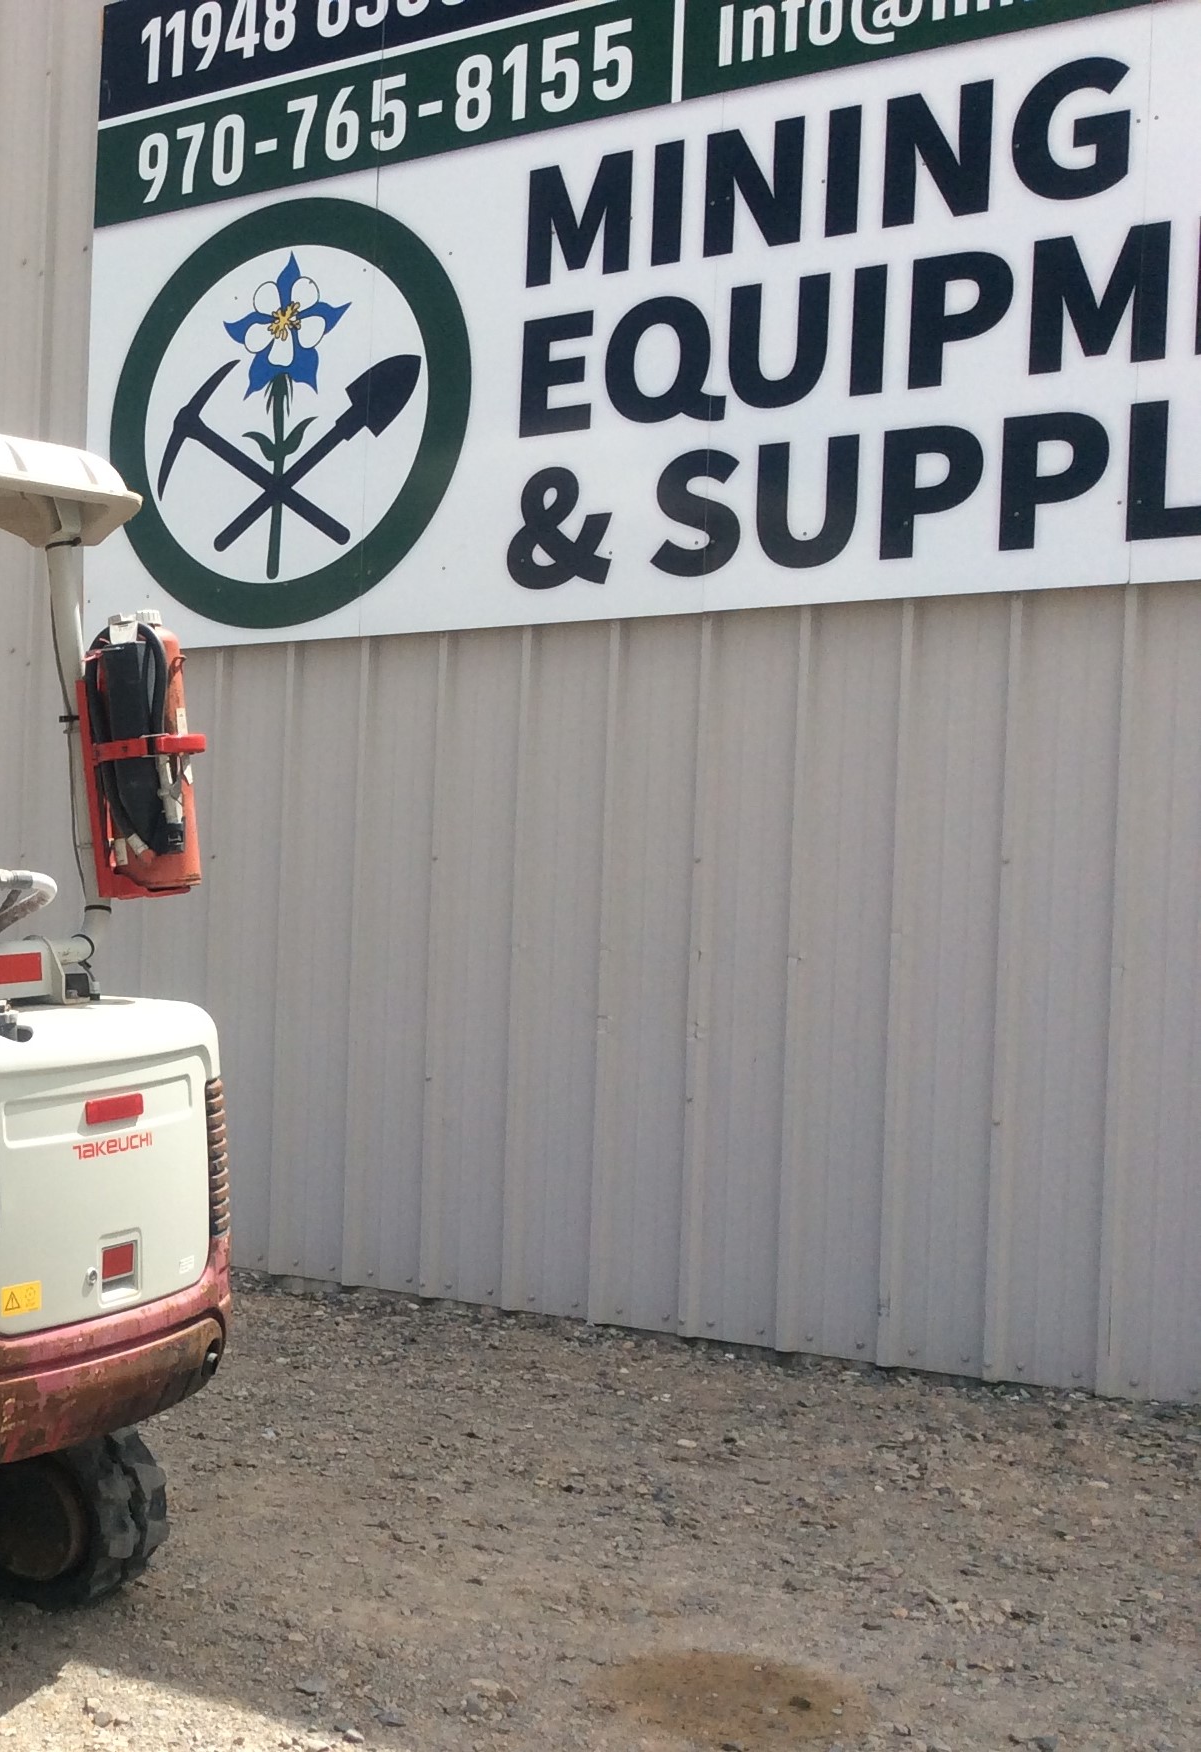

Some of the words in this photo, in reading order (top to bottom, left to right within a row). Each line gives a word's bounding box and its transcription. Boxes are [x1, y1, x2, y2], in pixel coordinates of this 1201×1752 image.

[138, 18, 634, 203] 970-765-8155
[140, 0, 297, 84] 11948
[525, 56, 1131, 288] MINING
[519, 216, 1201, 438] EQUIPM
[506, 466, 613, 590] &
[649, 399, 1201, 578] SUPPL
